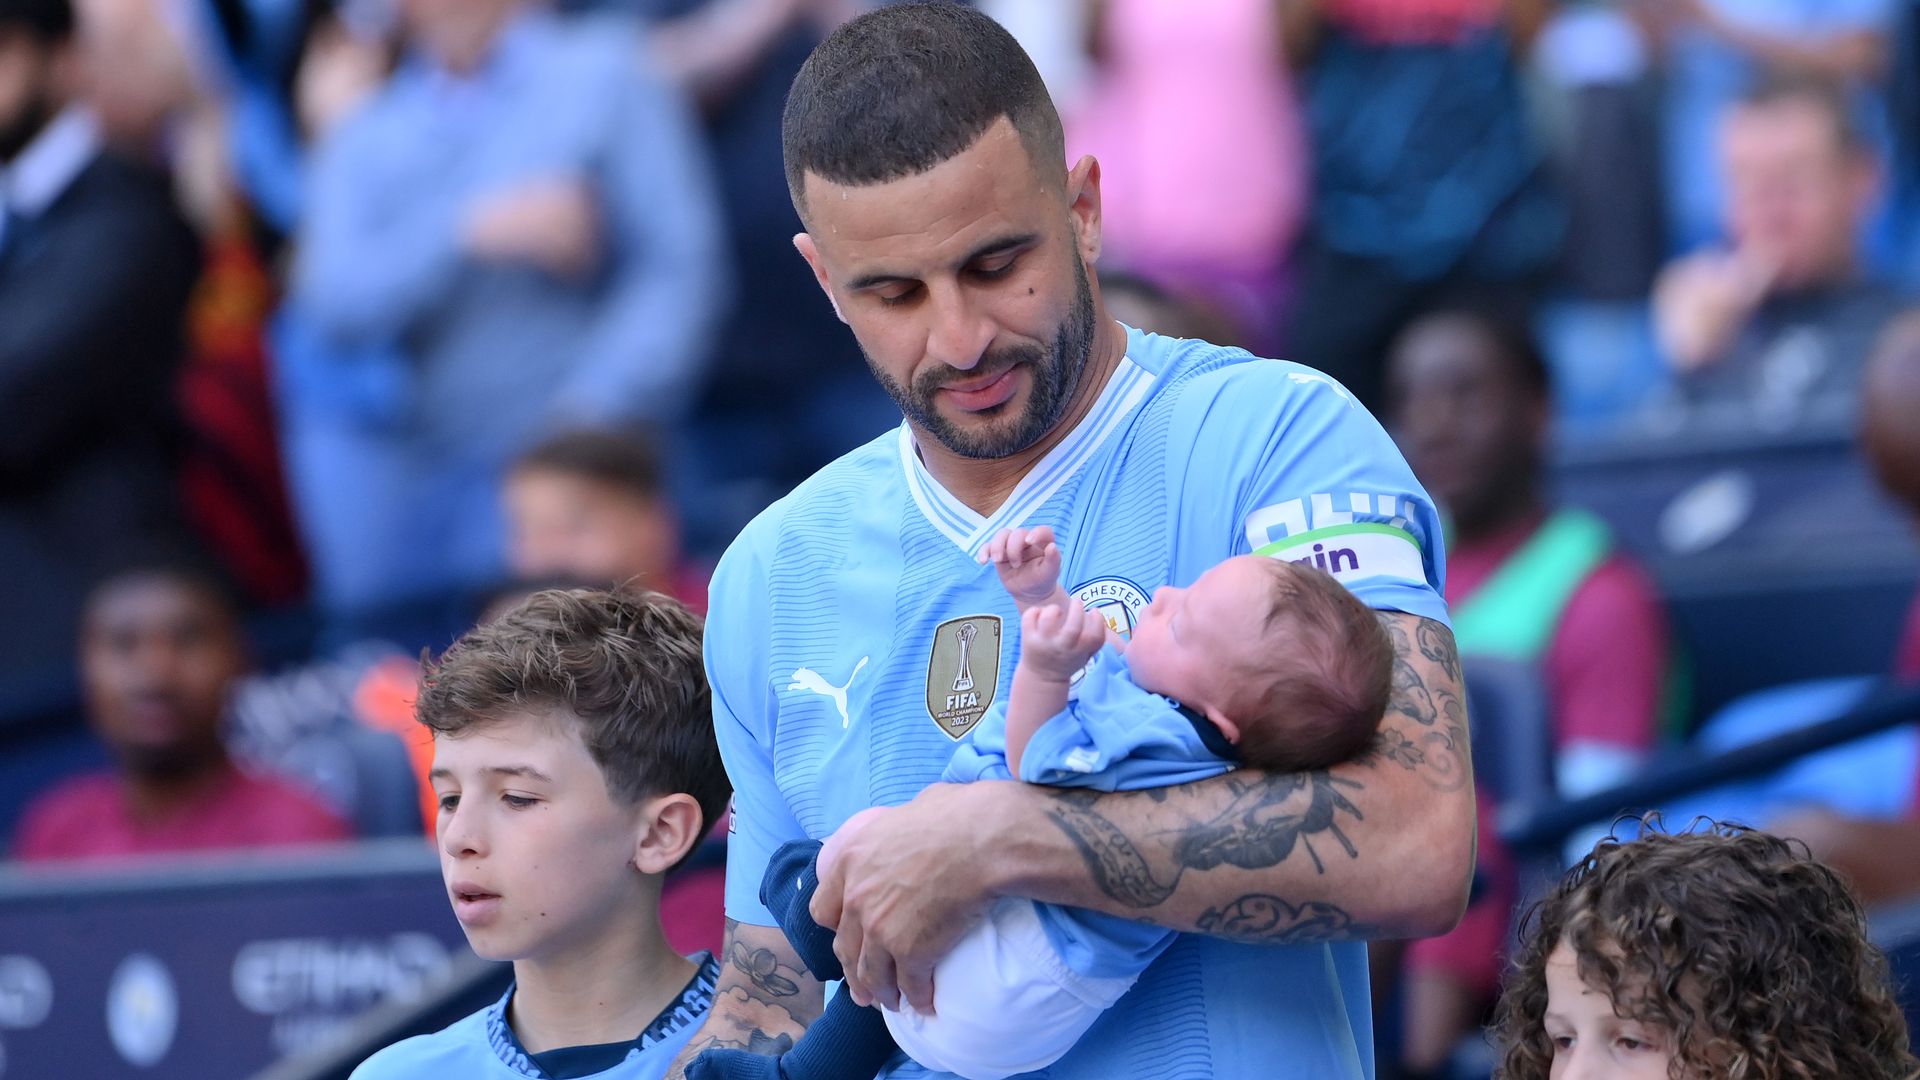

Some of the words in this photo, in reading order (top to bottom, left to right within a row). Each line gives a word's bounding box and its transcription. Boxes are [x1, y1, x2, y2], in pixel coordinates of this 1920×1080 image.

[1080, 585, 1142, 609] CHESTER
[946, 692, 978, 710] FIFA
[951, 715, 970, 726] 2023
